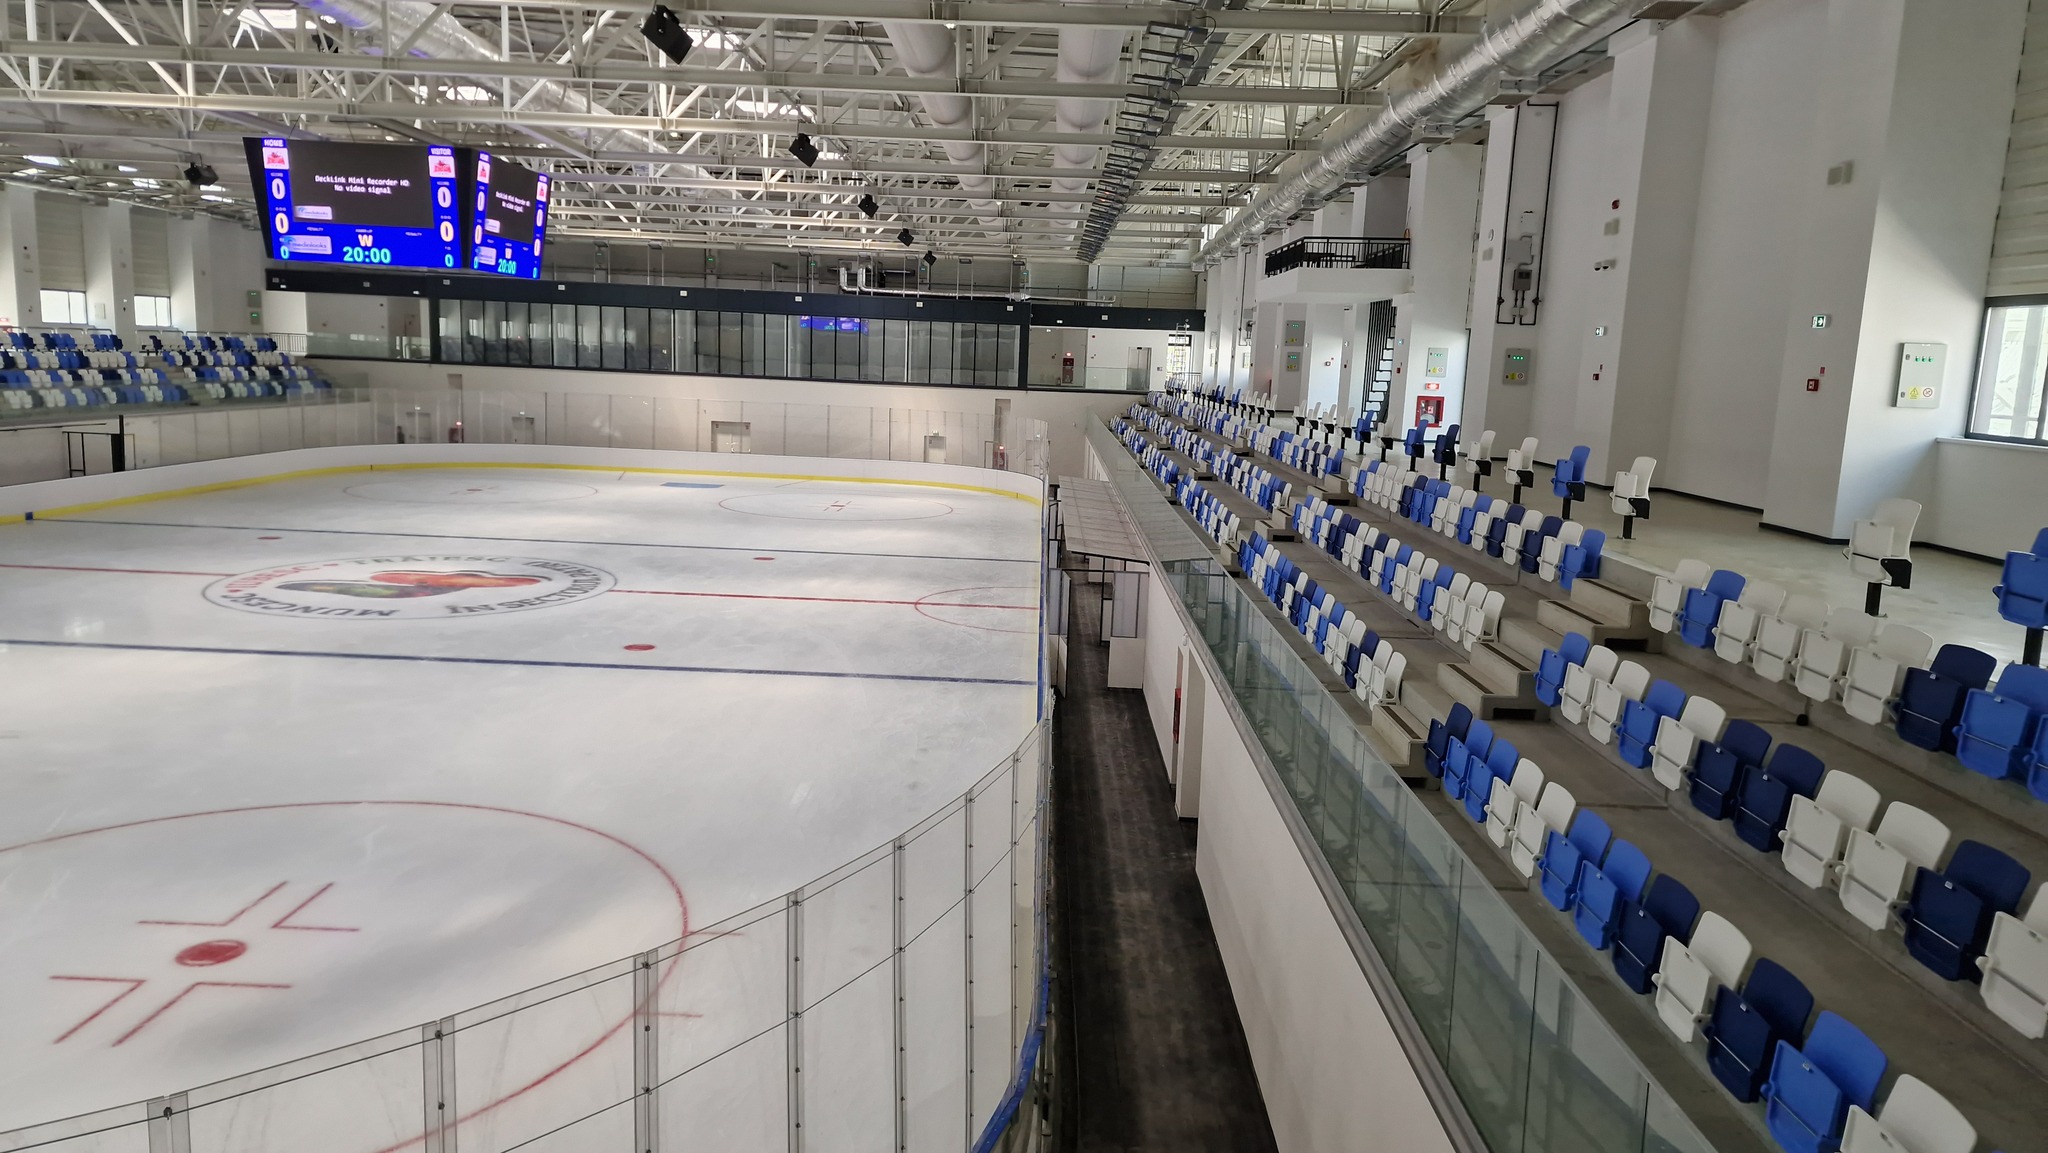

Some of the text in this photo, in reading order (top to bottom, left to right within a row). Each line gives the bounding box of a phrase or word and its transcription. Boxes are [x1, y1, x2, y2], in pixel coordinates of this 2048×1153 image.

[264, 139, 284, 147] HOME
[272, 178, 286, 200] 0
[315, 175, 346, 183] DeckLink
[366, 178, 398, 186] Recorder
[368, 186, 392, 194] signal
[437, 186, 452, 208] 0
[275, 212, 288, 234] 0
[440, 220, 454, 242] 0
[358, 234, 374, 247] W
[280, 246, 290, 260] 0
[342, 246, 392, 264] 20:00
[444, 254, 454, 268] 0
[498, 258, 516, 274] 20:00
[496, 577, 600, 608] SECTORUL
[220, 592, 400, 616] MUNCESC
